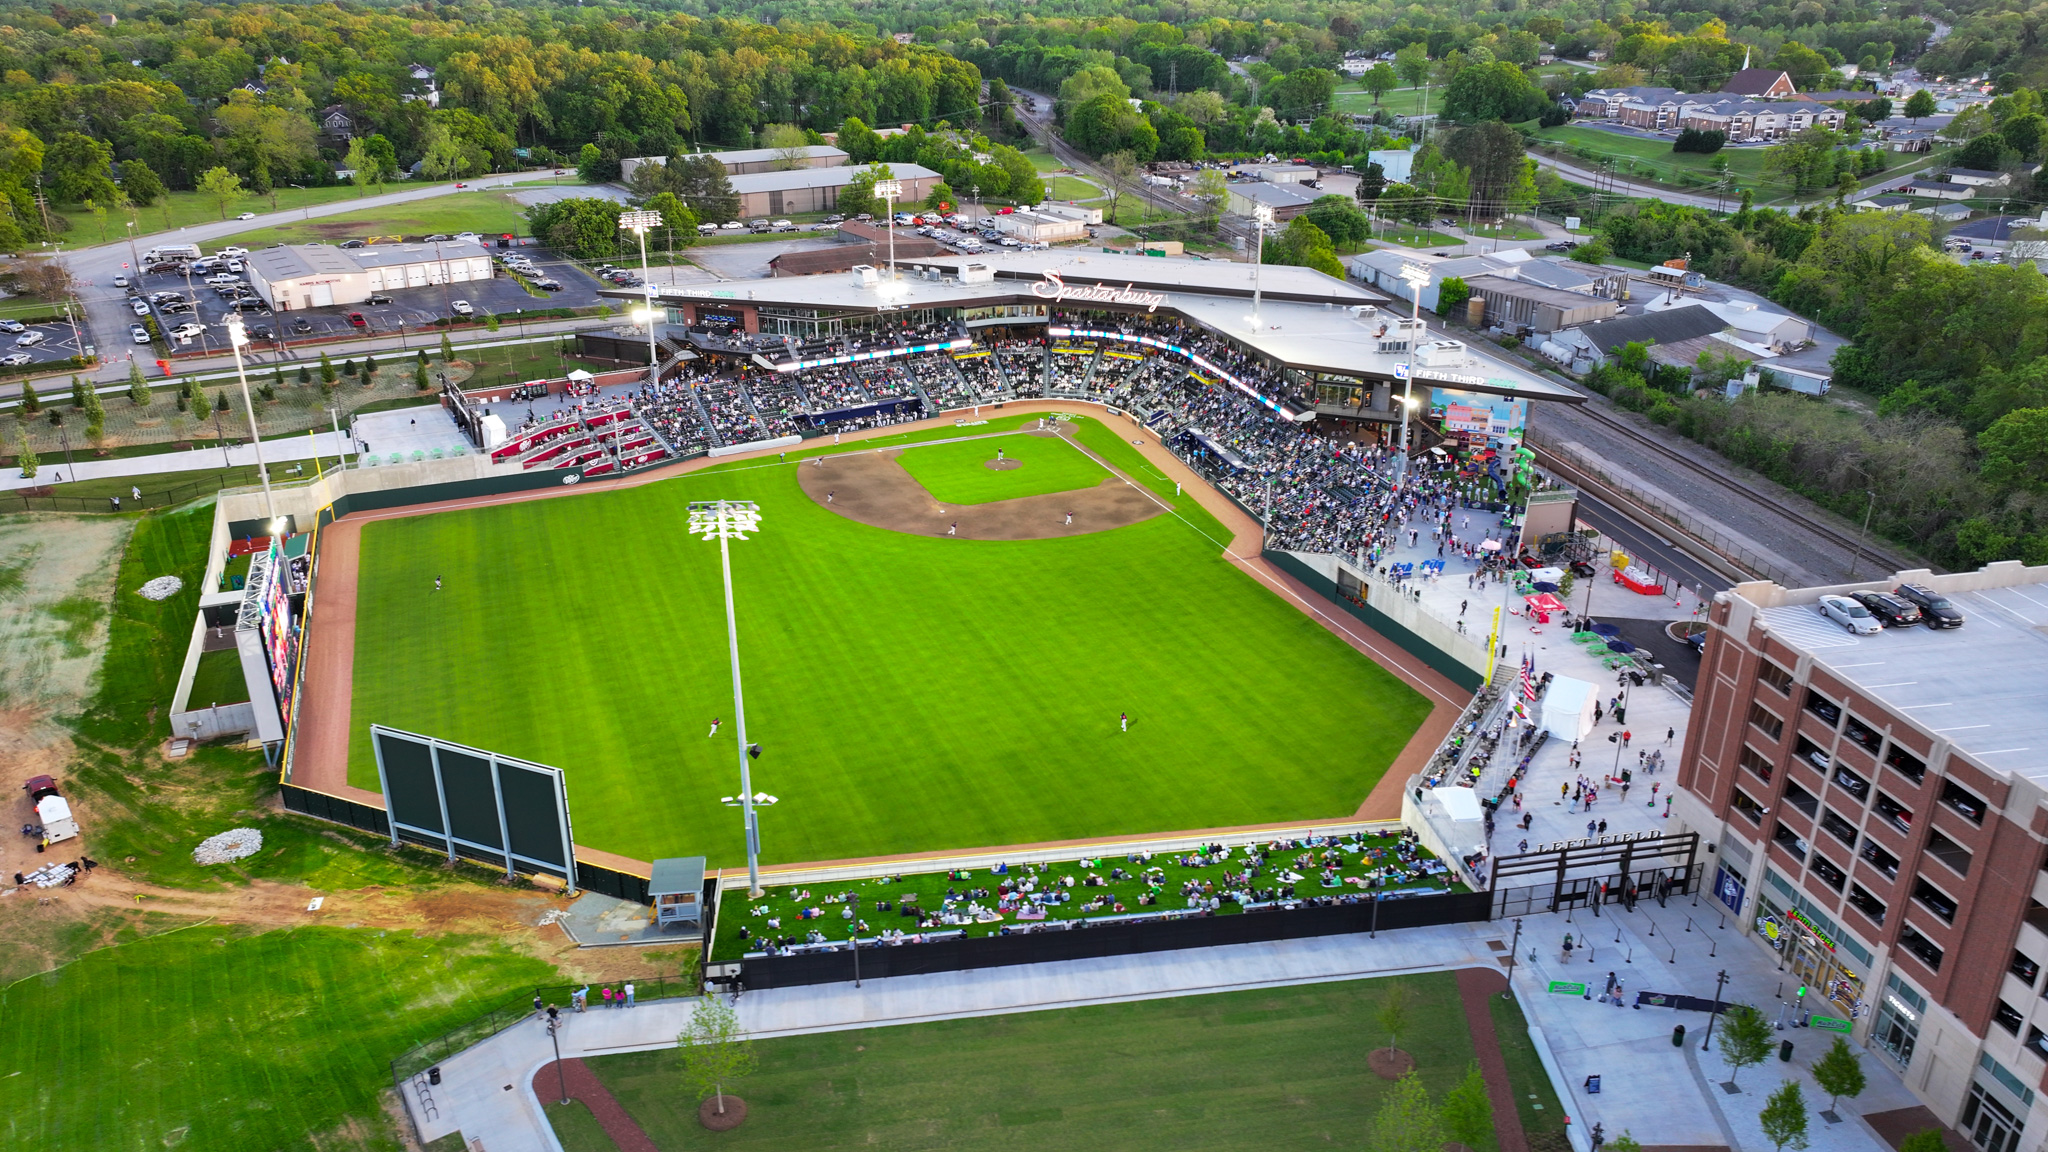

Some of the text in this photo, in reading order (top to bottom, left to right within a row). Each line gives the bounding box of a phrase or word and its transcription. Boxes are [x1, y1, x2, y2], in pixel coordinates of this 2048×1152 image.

[1031, 269, 1164, 312] Spartanburg
[1416, 369, 1447, 381] FIFTH
[1451, 373, 1485, 385] THIRD
[1536, 829, 1662, 853] LEFT FIELD
[1811, 925, 1836, 948] STORE
[1888, 995, 1916, 1020] TICKETS
